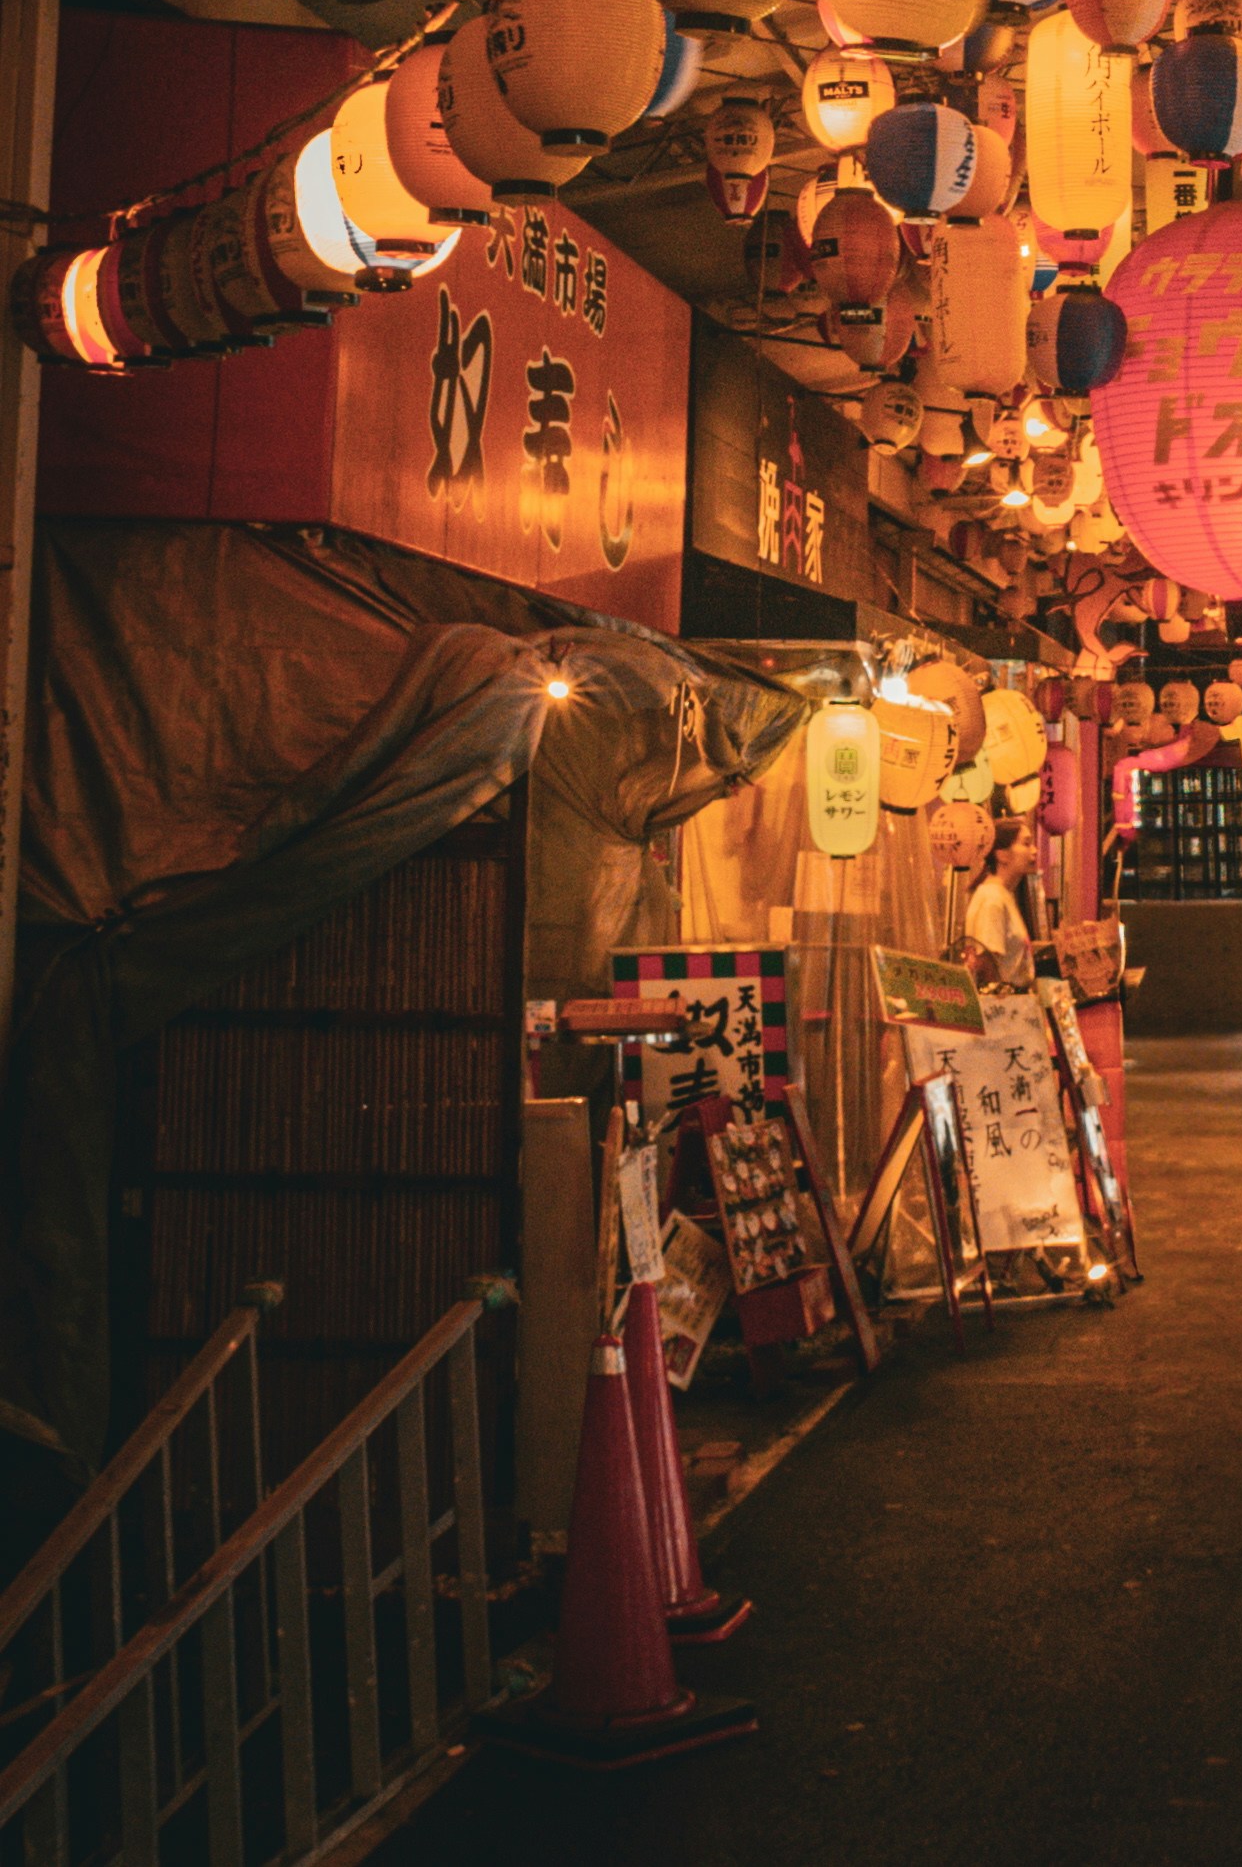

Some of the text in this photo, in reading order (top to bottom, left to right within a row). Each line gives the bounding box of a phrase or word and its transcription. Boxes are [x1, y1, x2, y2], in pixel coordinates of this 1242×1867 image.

[825, 789, 867, 802] レモン
[824, 805, 867, 820] サワー
[977, 1084, 1012, 1159] 和風
